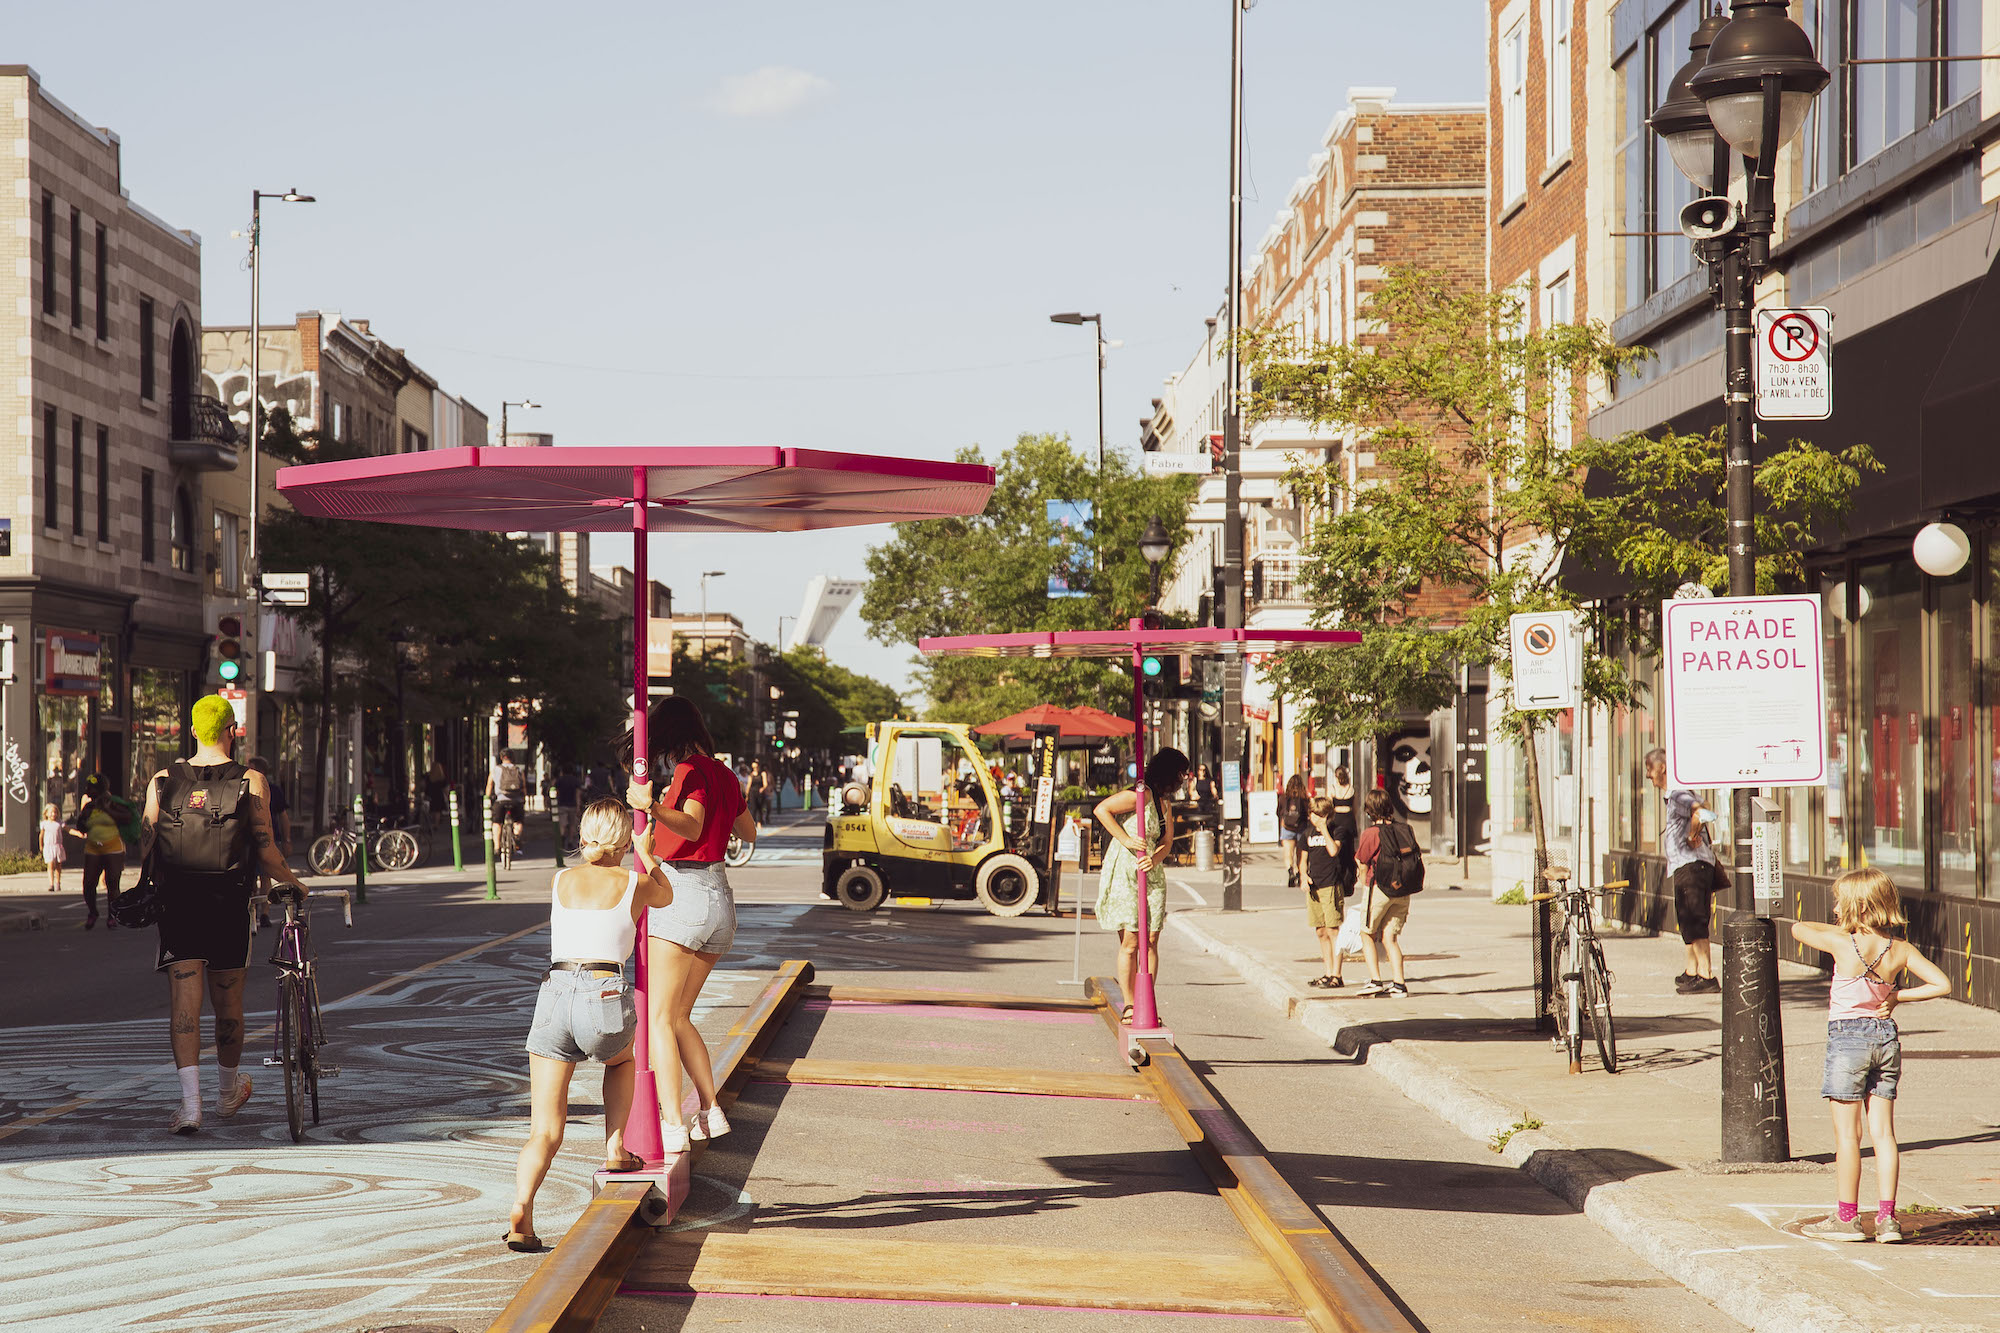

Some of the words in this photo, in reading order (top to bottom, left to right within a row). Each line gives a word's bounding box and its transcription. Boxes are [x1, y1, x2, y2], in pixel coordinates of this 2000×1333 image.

[1768, 363, 1790, 374] 7h30
[1797, 363, 1820, 374] 8h30
[1770, 376, 1789, 387] LUN
[1799, 376, 1817, 386] VEN
[1770, 388, 1791, 398] AVRIL
[1810, 386, 1825, 398] DÉC
[1151, 458, 1184, 469] Fabre
[1690, 618, 1796, 642] PARADE
[1682, 648, 1806, 672] PARASOL
[1770, 873, 1775, 884] ON
